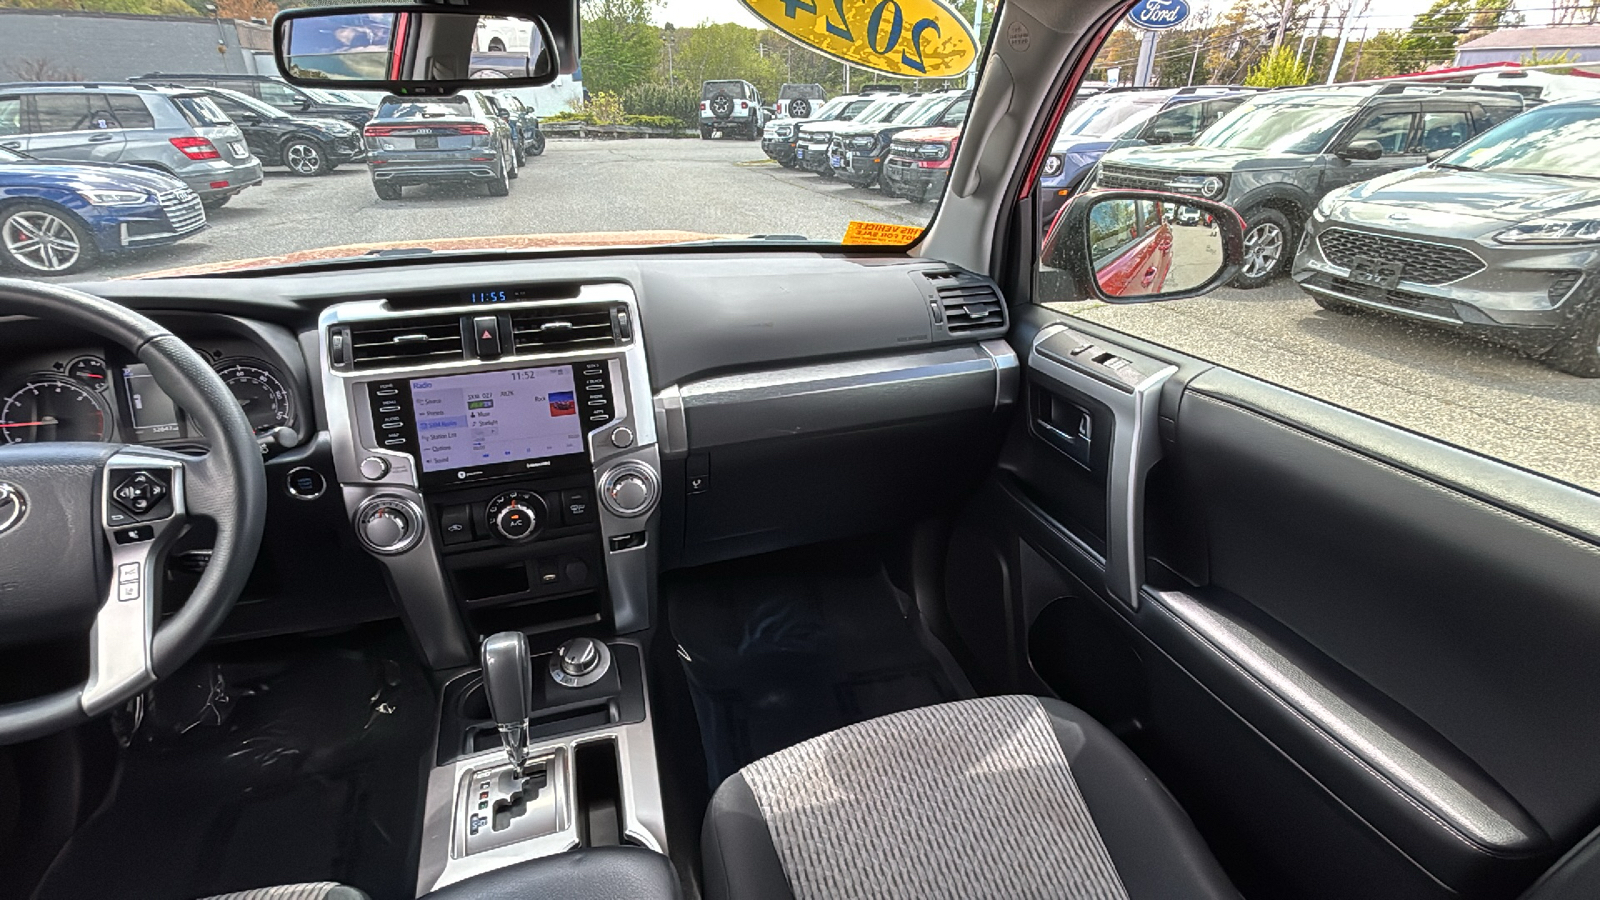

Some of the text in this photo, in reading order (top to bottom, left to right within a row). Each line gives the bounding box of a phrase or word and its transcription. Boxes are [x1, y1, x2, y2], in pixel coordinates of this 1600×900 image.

[1140, 0, 1181, 22] Ford
[471, 291, 506, 303] 11:55
[511, 370, 536, 381] 11:52
[412, 382, 433, 390] Radio
[429, 432, 448, 440] Station
[510, 519, 523, 527] A/C
